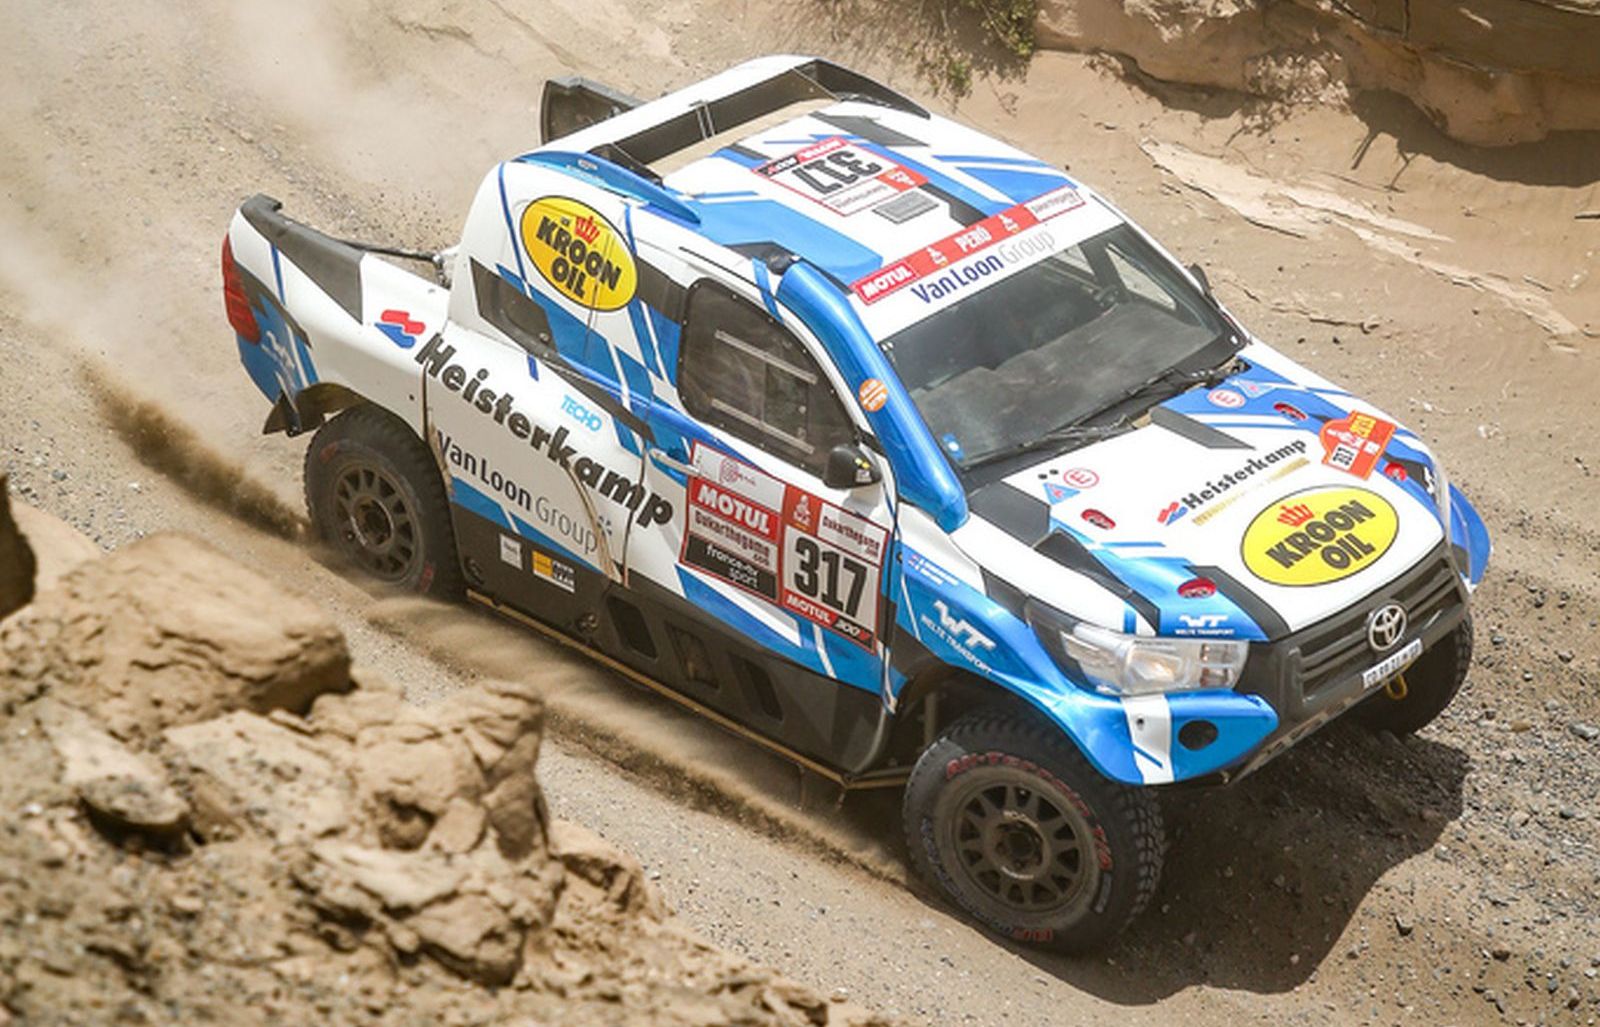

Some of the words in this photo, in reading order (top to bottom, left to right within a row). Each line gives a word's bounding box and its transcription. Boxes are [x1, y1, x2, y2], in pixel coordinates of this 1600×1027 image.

[792, 150, 882, 194] 317
[536, 216, 622, 291] KROON
[551, 256, 587, 299] OIL
[861, 264, 912, 297] MOTUL
[910, 276, 952, 304] Van
[952, 253, 1004, 286] Loon
[998, 230, 1057, 265] Group
[414, 332, 674, 528] Heisterkamp
[436, 430, 478, 476] Van
[481, 459, 532, 511] Loon
[535, 496, 598, 555] Group
[697, 483, 770, 535] MOTUL
[1181, 439, 1307, 509] Heisterkamp
[1264, 499, 1377, 569] KROON
[1320, 533, 1377, 570] OIL
[786, 593, 831, 624] MOTUL
[793, 536, 868, 618] 317
